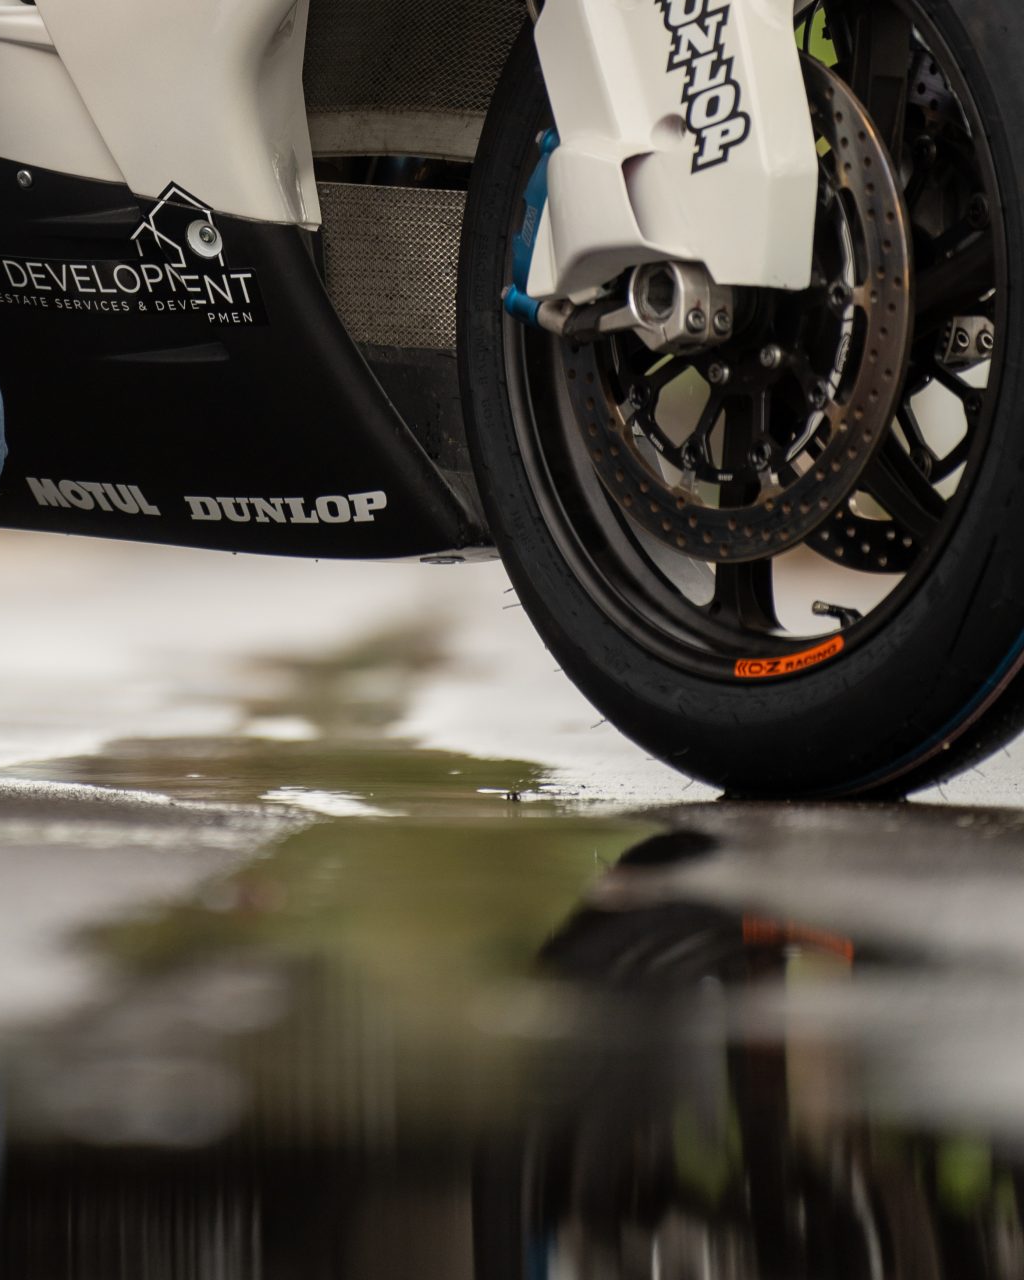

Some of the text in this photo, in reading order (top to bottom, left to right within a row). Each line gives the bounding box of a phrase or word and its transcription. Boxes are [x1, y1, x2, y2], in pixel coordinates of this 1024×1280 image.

[55, 298, 130, 311] SERVICES
[138, 302, 147, 311] &
[26, 477, 161, 516] MOTUL
[184, 490, 388, 524] DUNLOP
[785, 644, 837, 670] RACING
